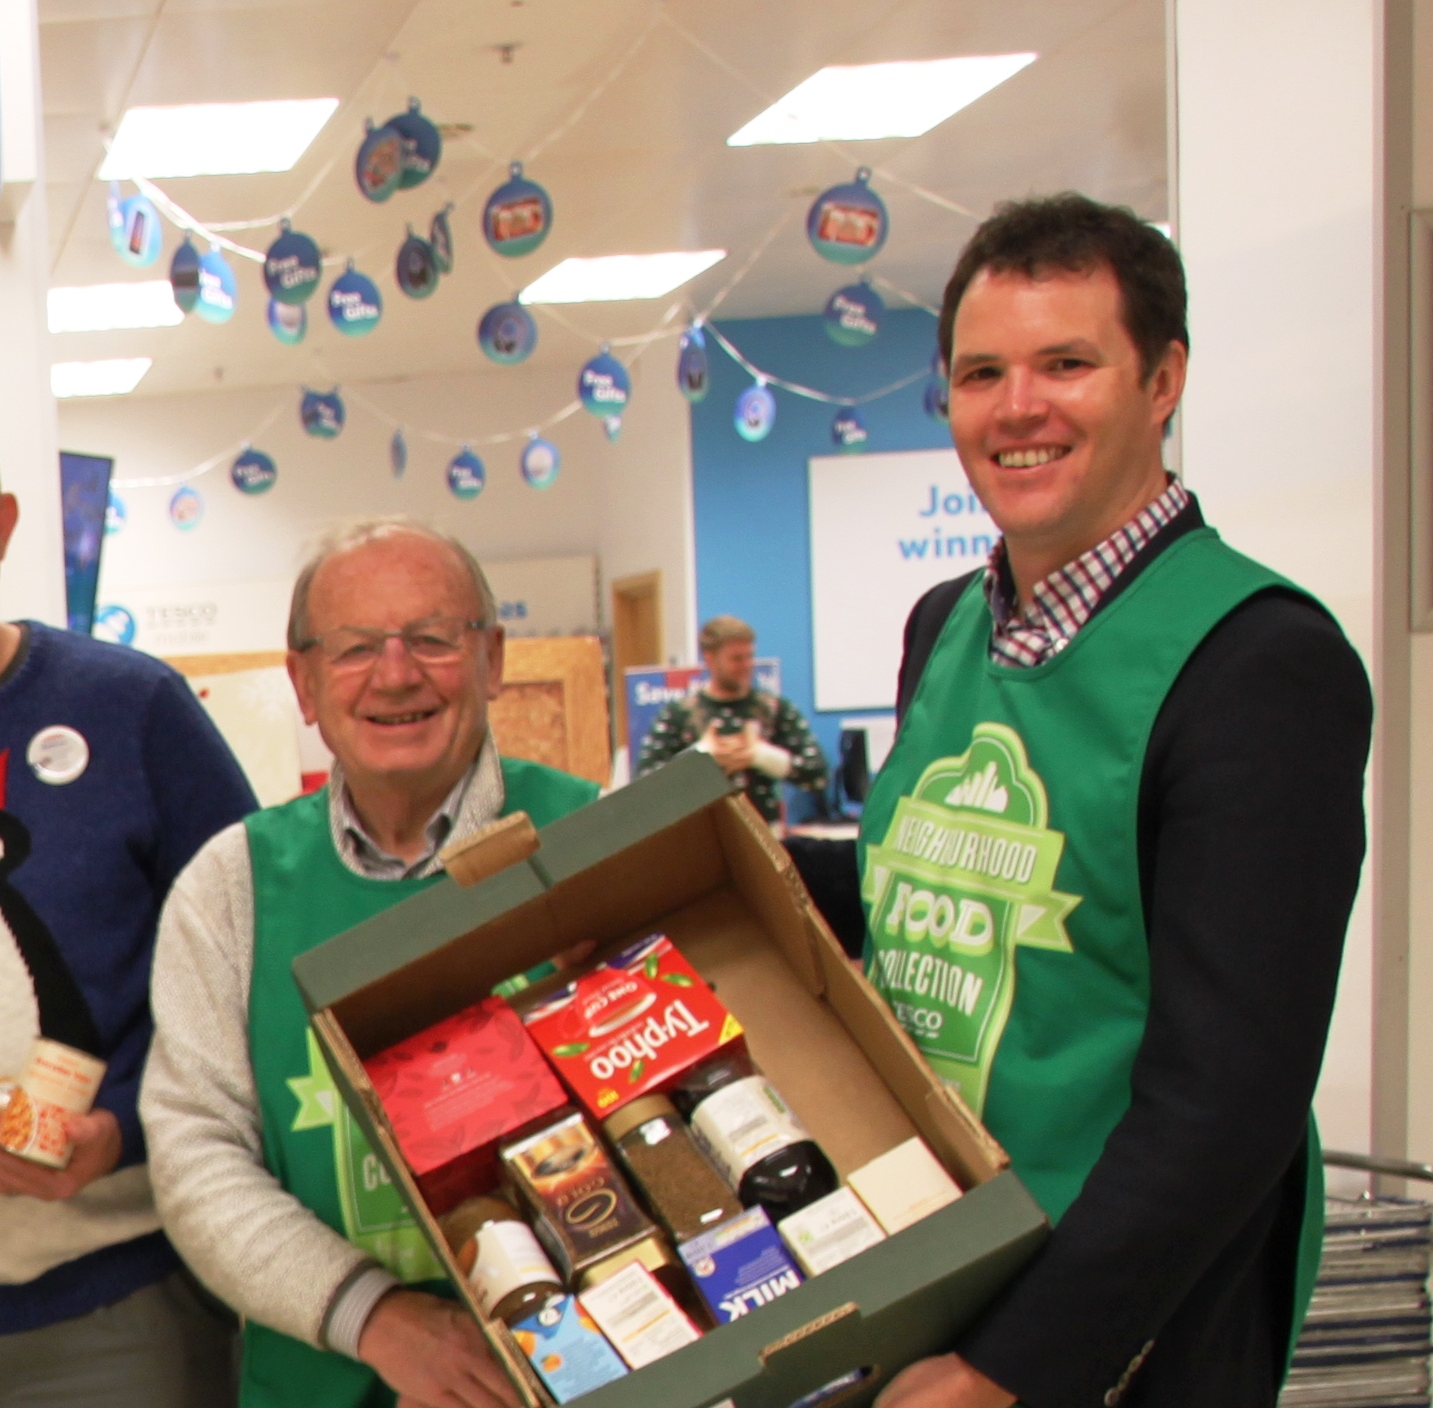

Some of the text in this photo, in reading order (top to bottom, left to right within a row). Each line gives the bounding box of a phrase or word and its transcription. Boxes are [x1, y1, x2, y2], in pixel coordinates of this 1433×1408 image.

[330, 290, 361, 307] Free
[835, 295, 866, 314] Free
[343, 303, 378, 321] Gifts
[840, 315, 878, 335] Gifts
[584, 369, 613, 386] Free
[593, 387, 626, 403] Gifts
[918, 485, 983, 517] Joi
[146, 602, 218, 620] TESCO
[886, 881, 993, 947] FOOD
[719, 1268, 802, 1323] MILK
